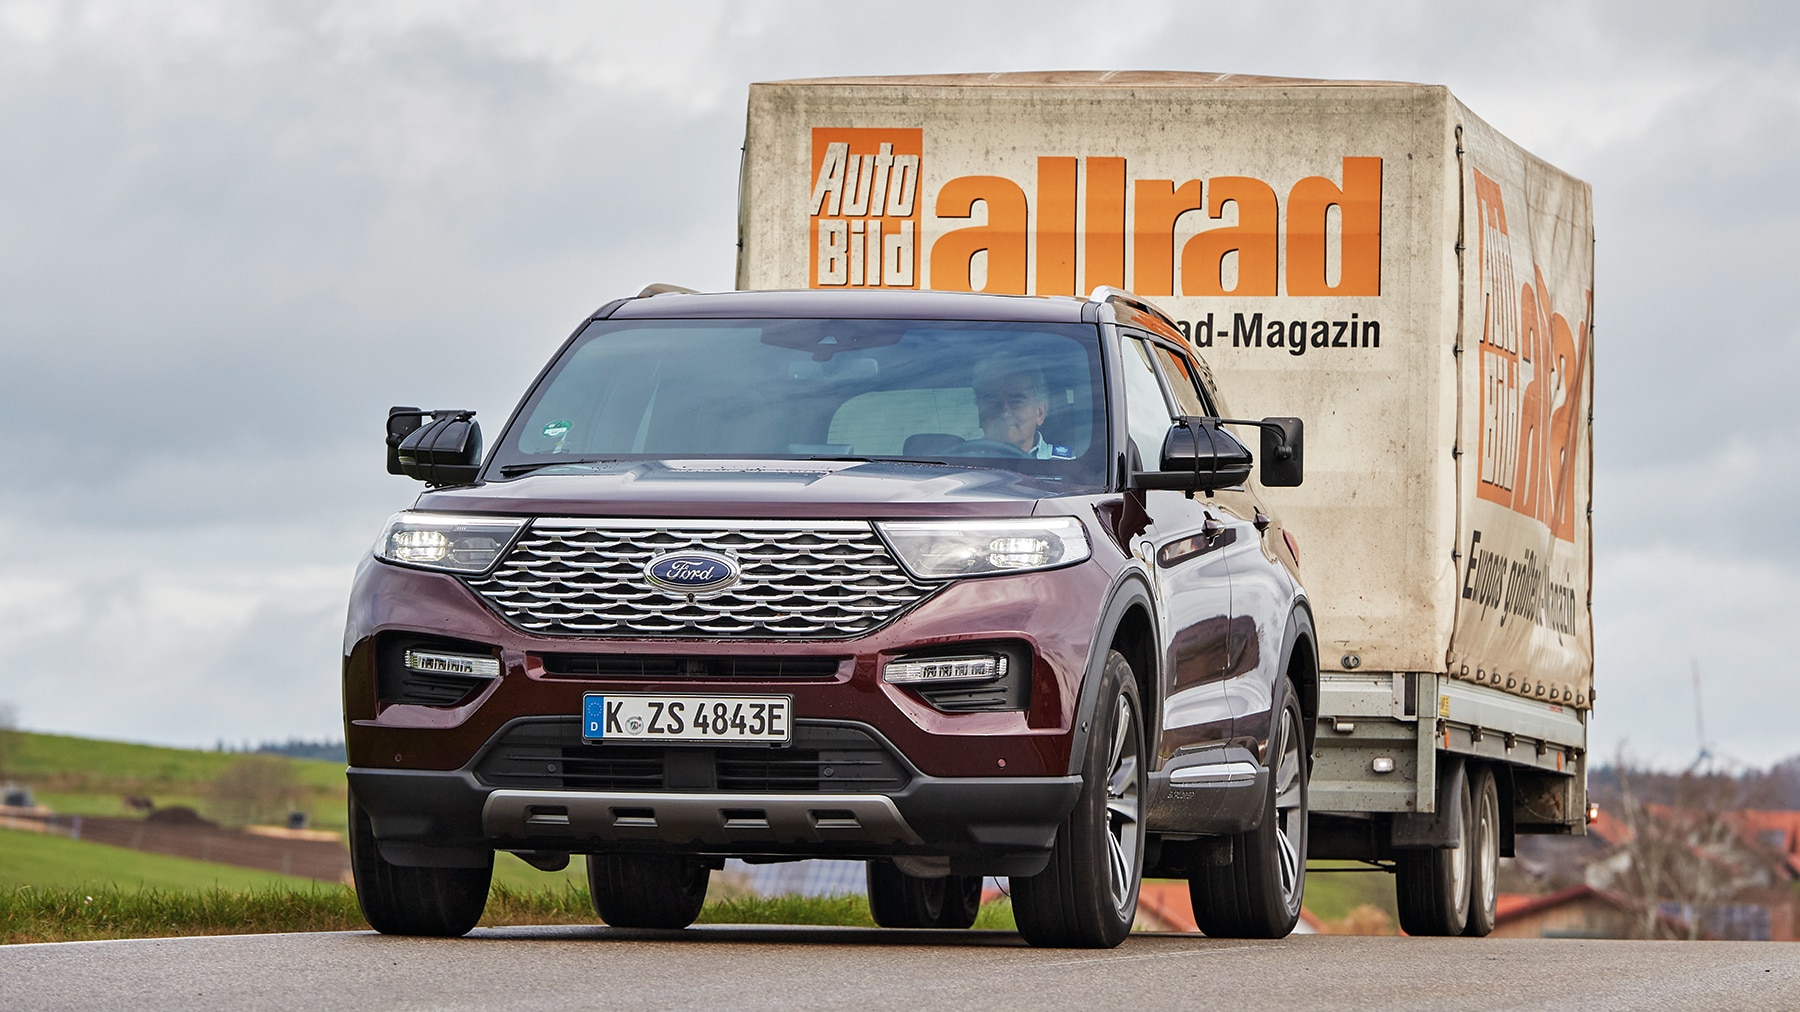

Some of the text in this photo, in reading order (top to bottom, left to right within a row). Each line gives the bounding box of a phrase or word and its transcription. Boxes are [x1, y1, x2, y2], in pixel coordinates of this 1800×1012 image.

[810, 142, 920, 217] Auto
[817, 219, 915, 286] Bild
[930, 156, 1382, 296] allrad
[1481, 350, 1518, 493] Bild
[666, 560, 715, 582] Ford
[590, 721, 599, 732] D
[606, 701, 785, 736] K ZS 4843E
